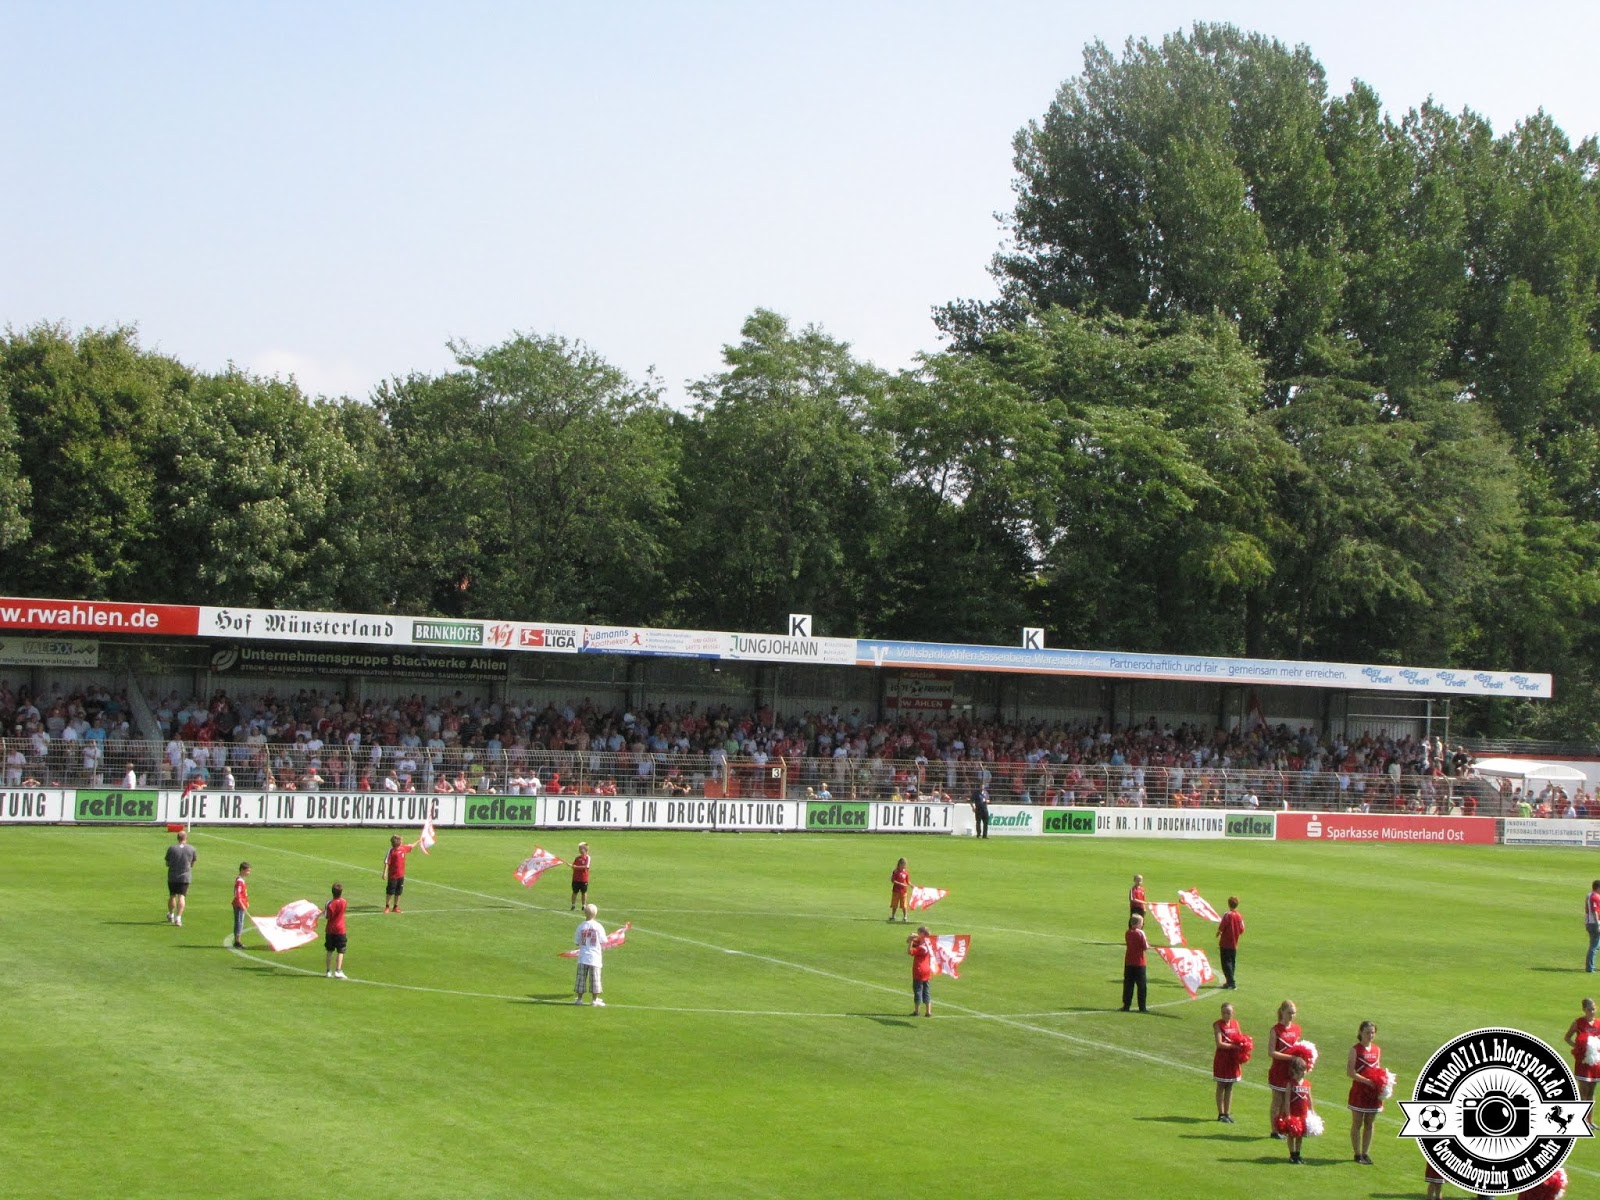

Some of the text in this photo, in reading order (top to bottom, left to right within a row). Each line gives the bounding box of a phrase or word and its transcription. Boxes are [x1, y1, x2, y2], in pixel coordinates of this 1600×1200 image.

[215, 610, 394, 638] Hof Münsterland
[791, 616, 807, 637] K
[545, 629, 576, 637] BUNDES
[1026, 630, 1040, 649] K
[545, 636, 576, 648] LIGA
[241, 648, 388, 666] Unternehmensgruppe
[470, 658, 507, 670] Ahlen
[897, 646, 946, 659] Volksbank
[1110, 658, 1347, 680] Partnerschaftlich und fair gemeinsam mehr erreichen.
[1370, 675, 1393, 684] Credit
[1408, 677, 1430, 686] Credit
[1444, 679, 1467, 688] Credit
[1482, 680, 1504, 690] Credit
[1518, 682, 1540, 691] Credit
[914, 700, 943, 708] AHLEN
[773, 768, 780, 778] 3
[79, 793, 154, 817] reflex
[179, 794, 440, 820] DIE NR. 1 IN DRUCKHALTUNG
[468, 799, 533, 821] reflex
[557, 800, 785, 825] DIE NR. 1 IN DRUCKHALTUNG
[809, 804, 866, 826] reflex
[883, 805, 948, 827] DIE NR. 1
[987, 811, 1032, 826] taxofit
[1045, 813, 1093, 831] reflex
[1097, 815, 1111, 830] DIE
[1116, 816, 1131, 830] NR.
[1143, 816, 1152, 831] IN
[1157, 816, 1223, 832] DRUCKHALTUNG
[1228, 816, 1272, 834] reflex
[1327, 825, 1379, 840] Sparkasse
[1381, 827, 1444, 840] Münsterland
[1446, 829, 1464, 841] Ost
